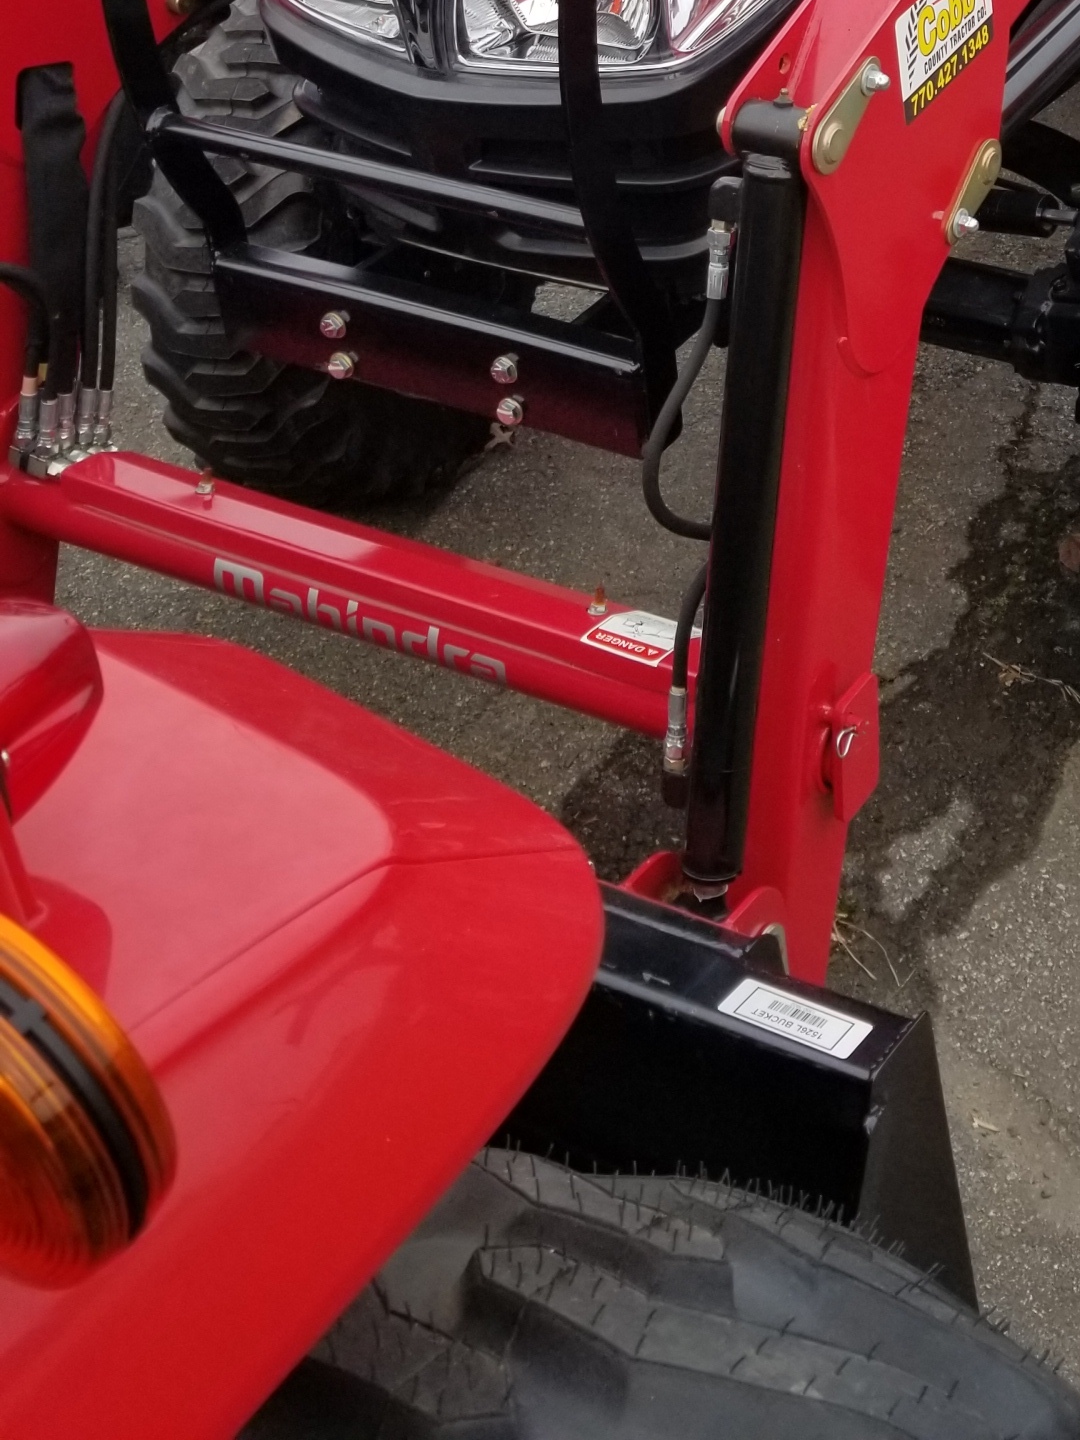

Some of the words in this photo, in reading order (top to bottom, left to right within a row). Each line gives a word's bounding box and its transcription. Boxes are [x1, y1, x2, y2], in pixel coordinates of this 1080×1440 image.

[924, 40, 948, 75] COUNTY
[950, 19, 976, 50] TRACTOR
[977, 6, 987, 22] CO.
[911, 24, 989, 117] 770.427.1348
[213, 557, 507, 686] Mahindra
[595, 632, 646, 653] DANGER
[752, 1008, 794, 1029] BUCKET
[797, 1023, 823, 1040] 1526L
